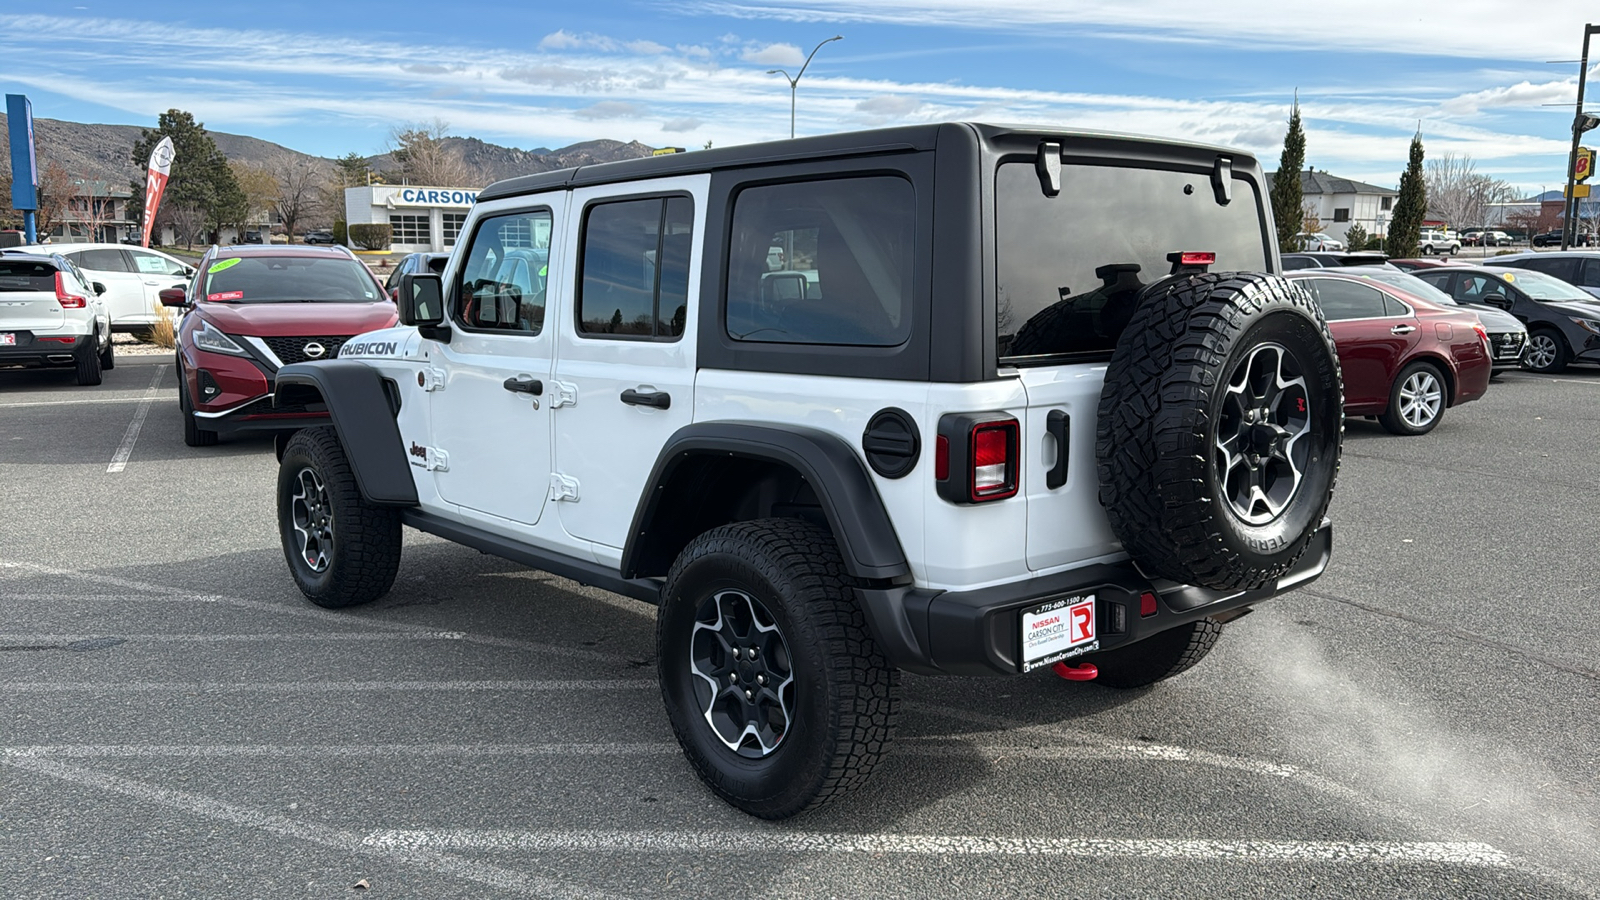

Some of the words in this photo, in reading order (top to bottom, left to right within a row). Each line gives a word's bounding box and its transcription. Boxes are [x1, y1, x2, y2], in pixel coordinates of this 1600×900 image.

[1575, 157, 1588, 173] 8
[403, 189, 477, 204] CARSON
[340, 342, 398, 356] RUBICON
[410, 440, 426, 461] Jeep
[1041, 596, 1080, 613] 775-600-1500
[1032, 616, 1060, 630] NISSAN
[1028, 628, 1052, 640] CARSON
[1052, 623, 1065, 633] CITY
[1030, 644, 1094, 670] www.NissanCarsonCity.com
